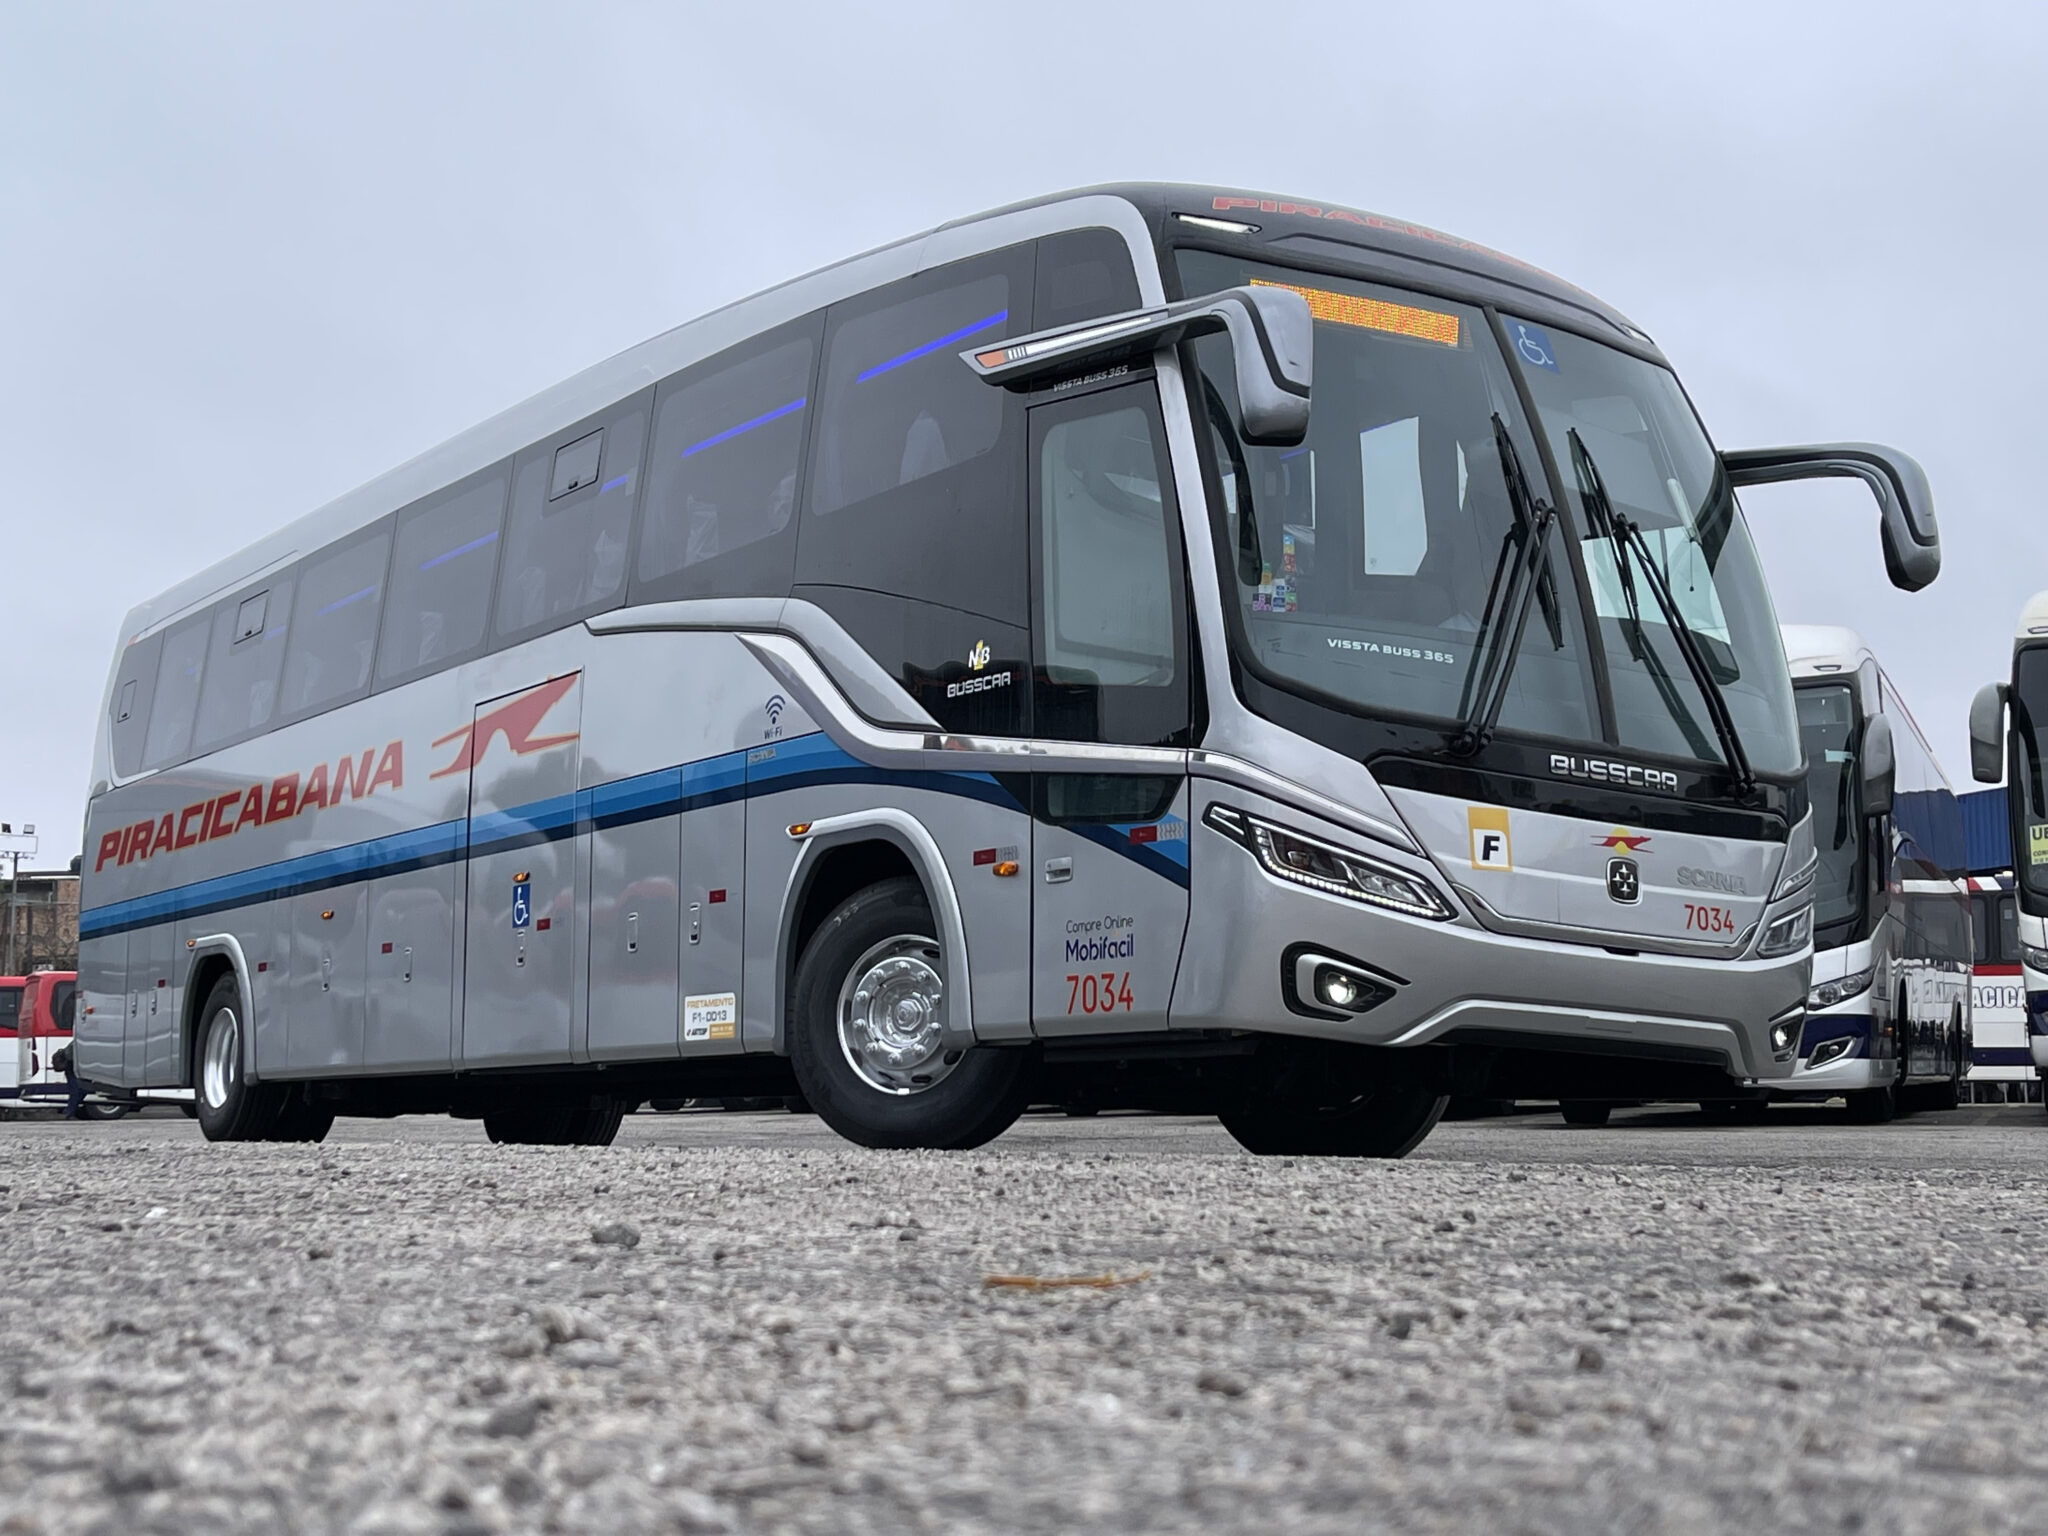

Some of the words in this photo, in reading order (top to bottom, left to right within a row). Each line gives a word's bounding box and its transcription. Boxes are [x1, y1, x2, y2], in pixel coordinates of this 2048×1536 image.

[1083, 369, 1108, 385] BUSS
[1108, 365, 1128, 378] 365
[1327, 638, 1380, 653] VISSTA
[1382, 644, 1422, 659] BUSS
[1423, 650, 1454, 664] 365
[947, 671, 1011, 698] BUSSCAR
[1550, 754, 1678, 792] BUSSCAR
[94, 739, 403, 874] PIRACICABANA
[1482, 835, 1500, 861] F
[1676, 866, 1746, 895] SCANIA
[1066, 920, 1101, 935] Compre
[1104, 916, 1134, 929] Online
[1684, 904, 1735, 934] 7034
[1066, 972, 1134, 1015] 7034
